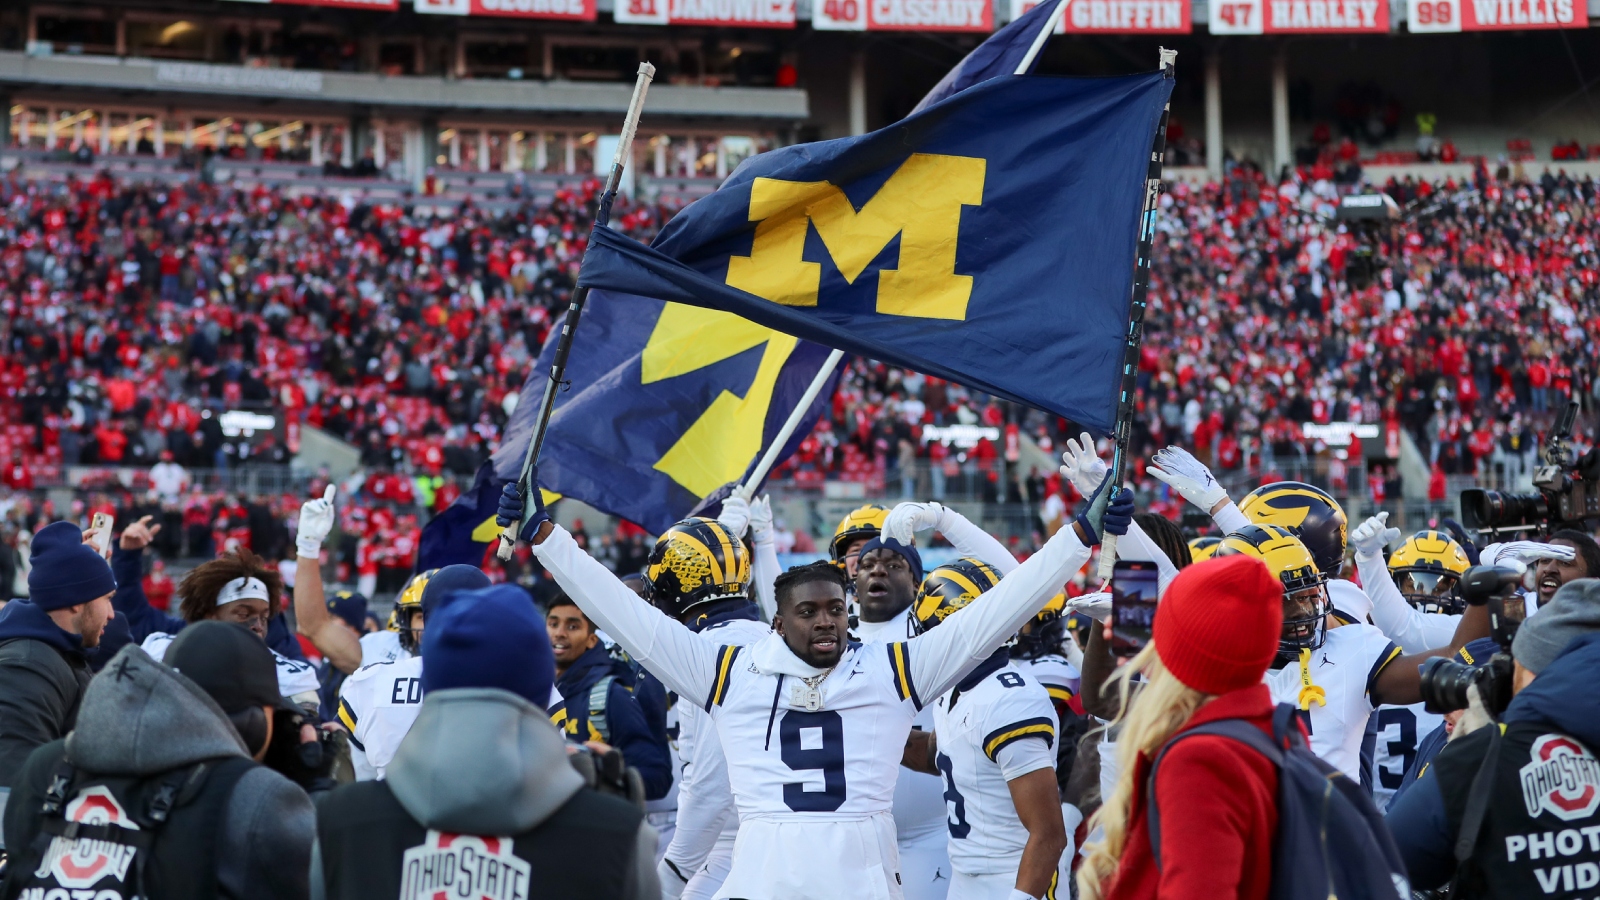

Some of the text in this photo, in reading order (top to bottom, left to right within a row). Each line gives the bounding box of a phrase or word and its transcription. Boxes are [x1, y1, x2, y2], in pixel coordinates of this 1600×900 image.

[824, 0, 985, 26] 40 CASSADY
[1071, 1, 1182, 28] GRIFFIN
[1220, 1, 1378, 28] 47 HARLEY
[1418, 0, 1574, 25] 99 WILLIS
[726, 153, 986, 320] M
[996, 672, 1025, 688] 8
[780, 709, 847, 812] 9
[1559, 753, 1600, 791] STAT
[1505, 826, 1600, 862] PHOT
[1534, 862, 1600, 893] VID
